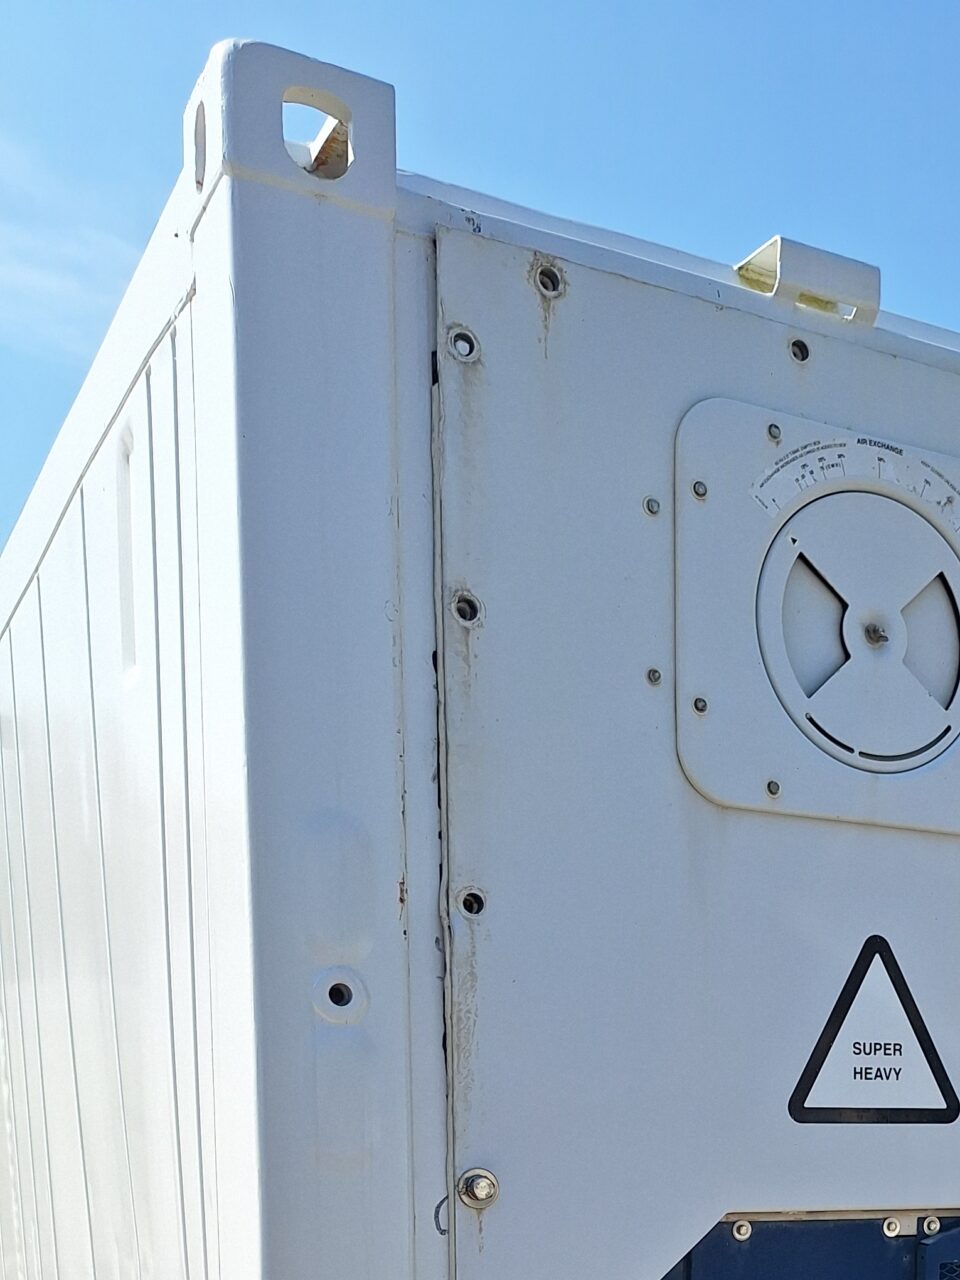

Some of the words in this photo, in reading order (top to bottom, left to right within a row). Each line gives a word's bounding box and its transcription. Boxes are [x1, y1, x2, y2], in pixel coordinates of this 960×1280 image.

[857, 437, 867, 446] AIR
[868, 438, 904, 456] EXCHANGE
[852, 1042, 903, 1056] SUPER
[853, 1066, 902, 1081] HEAVY
